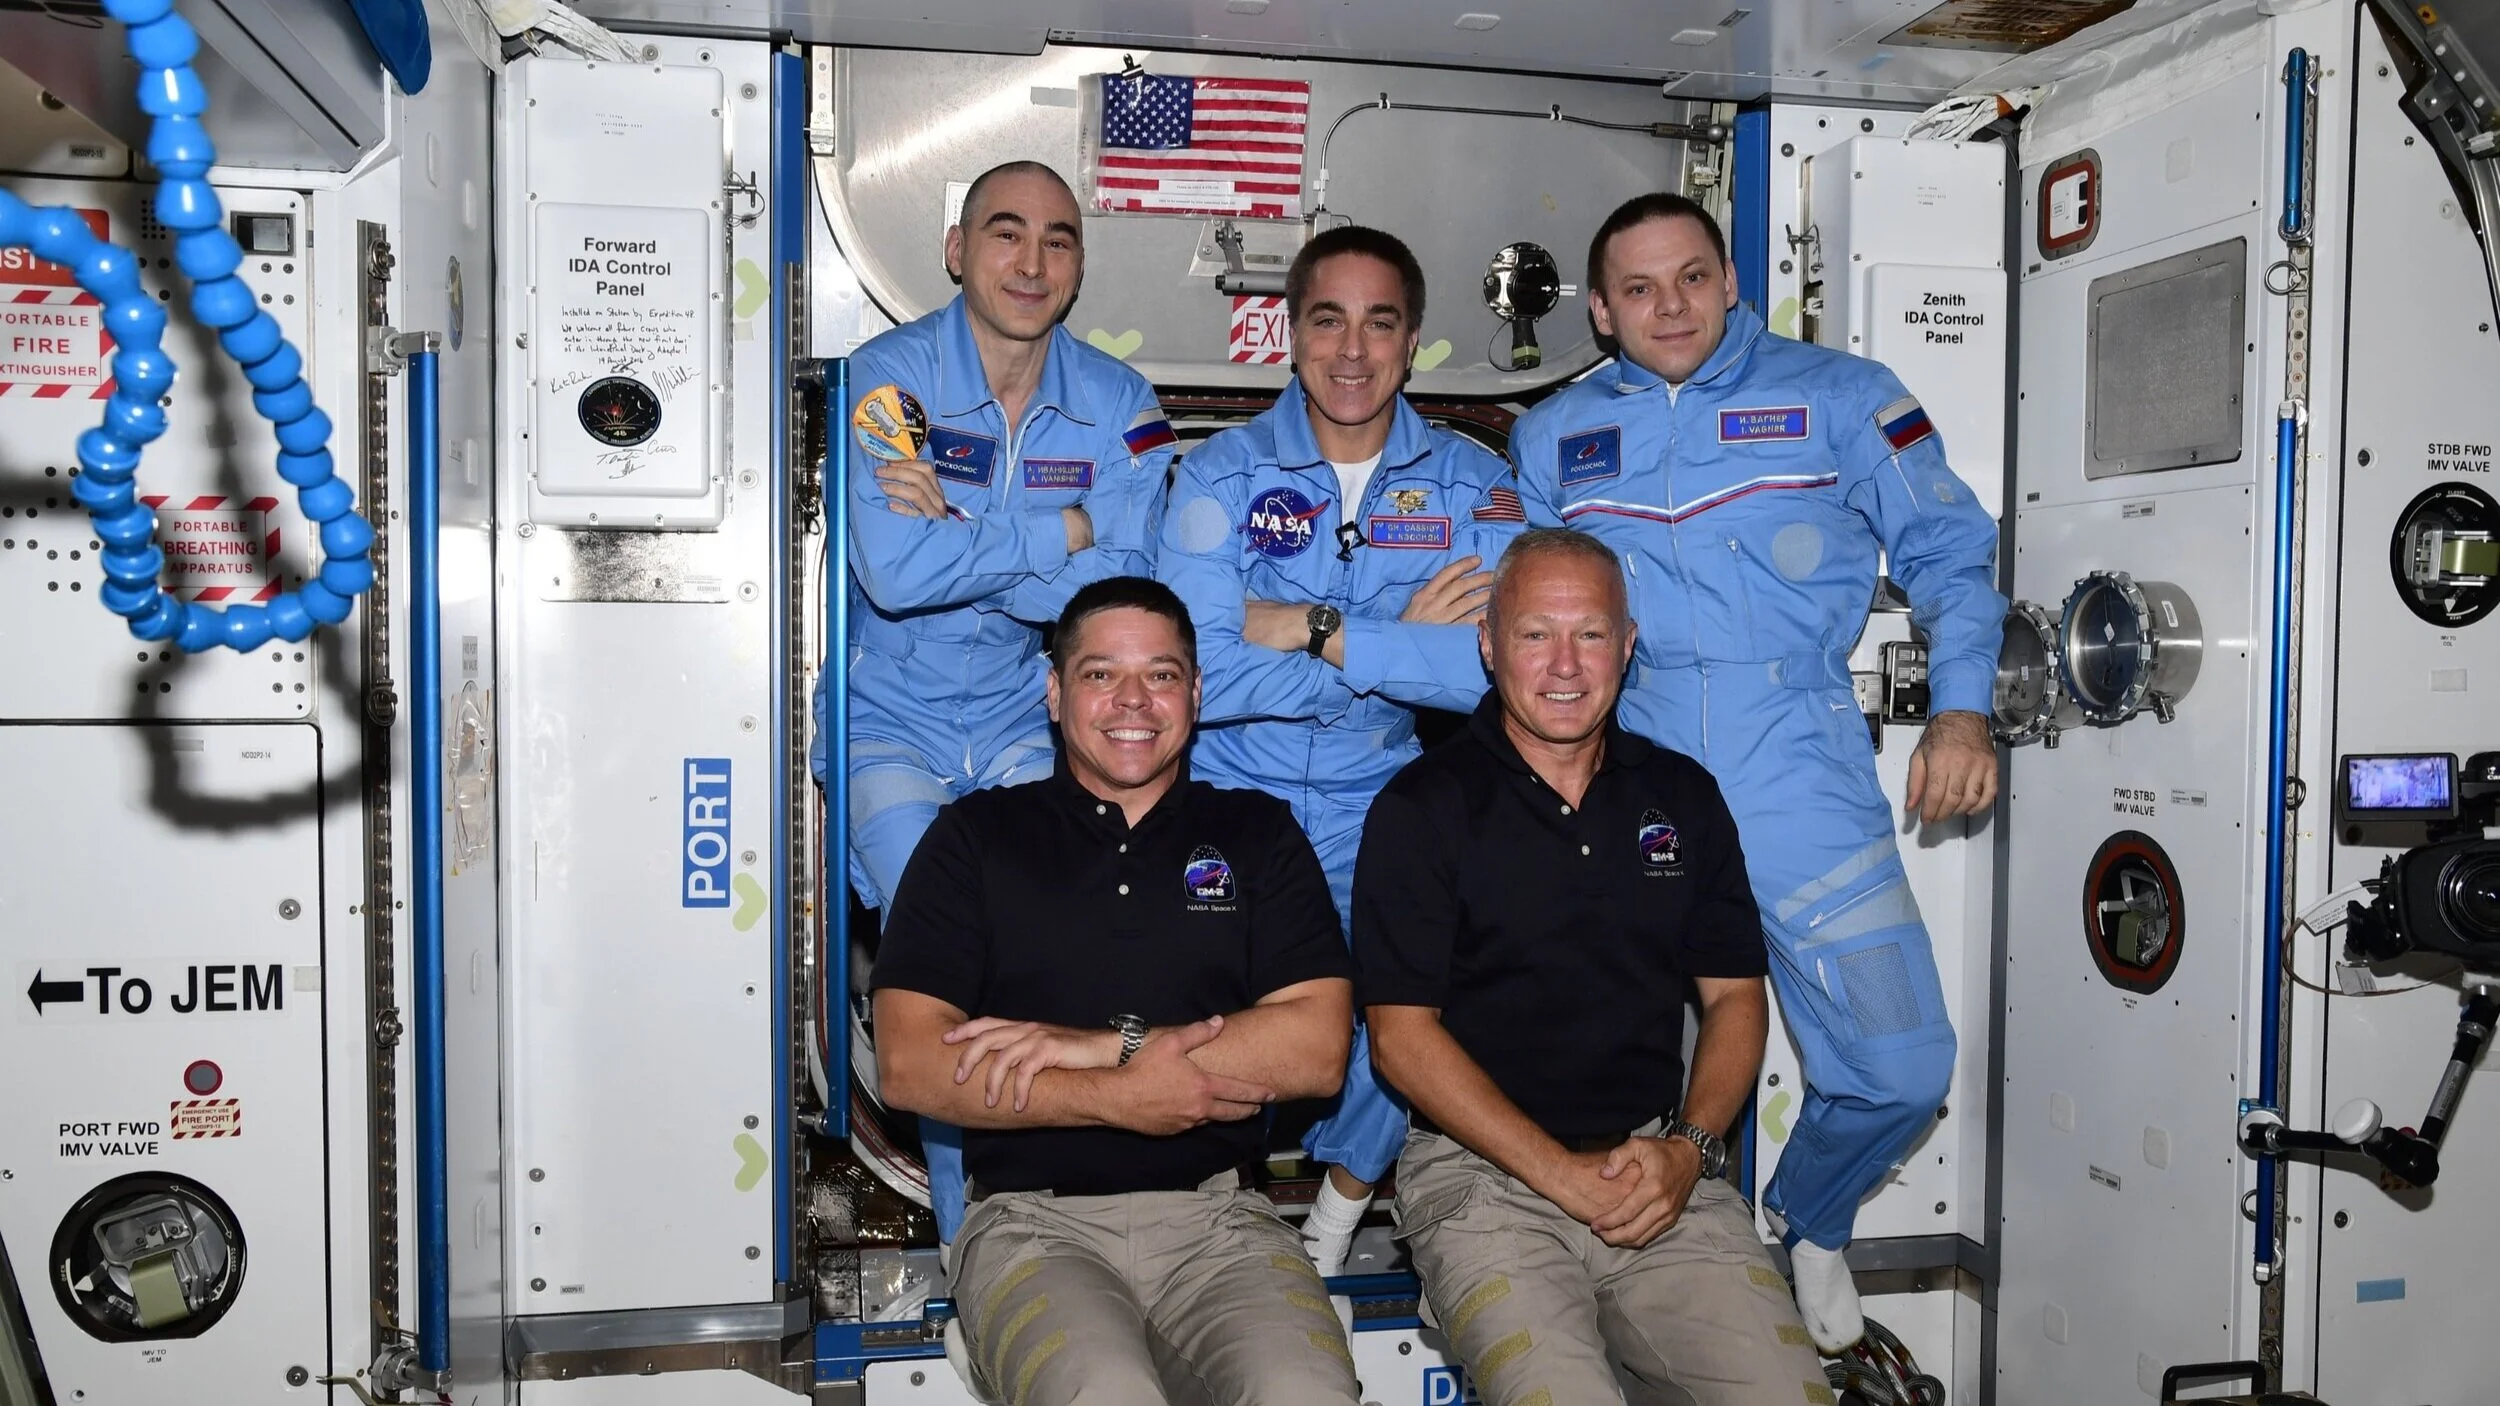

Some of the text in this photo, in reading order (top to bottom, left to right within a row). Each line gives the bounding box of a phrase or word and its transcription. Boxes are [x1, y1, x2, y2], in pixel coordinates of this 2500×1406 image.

[584, 237, 656, 254] Forward
[569, 258, 671, 276] IDA Control
[596, 281, 644, 296] Panel
[1923, 293, 1966, 306] Zenith
[0, 313, 89, 327] ORTABLE
[561, 305, 591, 317] Installed
[633, 307, 643, 322] by
[1905, 311, 1984, 326] IDA Control
[561, 323, 572, 333] We
[1244, 312, 1290, 347] EXI
[1925, 331, 1963, 344] Panel
[13, 337, 71, 354] FIRE
[0, 364, 97, 377] XTINGUISHER
[1749, 425, 1785, 434] VAGNER
[2428, 443, 2492, 457] STDB FWD
[2427, 459, 2490, 473] IMV VALVE
[174, 521, 248, 532] PORTABLE
[1250, 512, 1312, 535] NASA
[164, 541, 258, 555] BREATHING
[170, 563, 253, 574] APPARATUS
[2113, 788, 2156, 802] FWD STBD
[2113, 802, 2155, 816] IMV VALVE
[687, 763, 727, 899] PORT
[86, 964, 283, 1014] To JEM
[181, 1115, 230, 1124] FIRE PORT
[59, 1122, 160, 1137] PORT FWD
[60, 1142, 159, 1157] IMV VALVE
